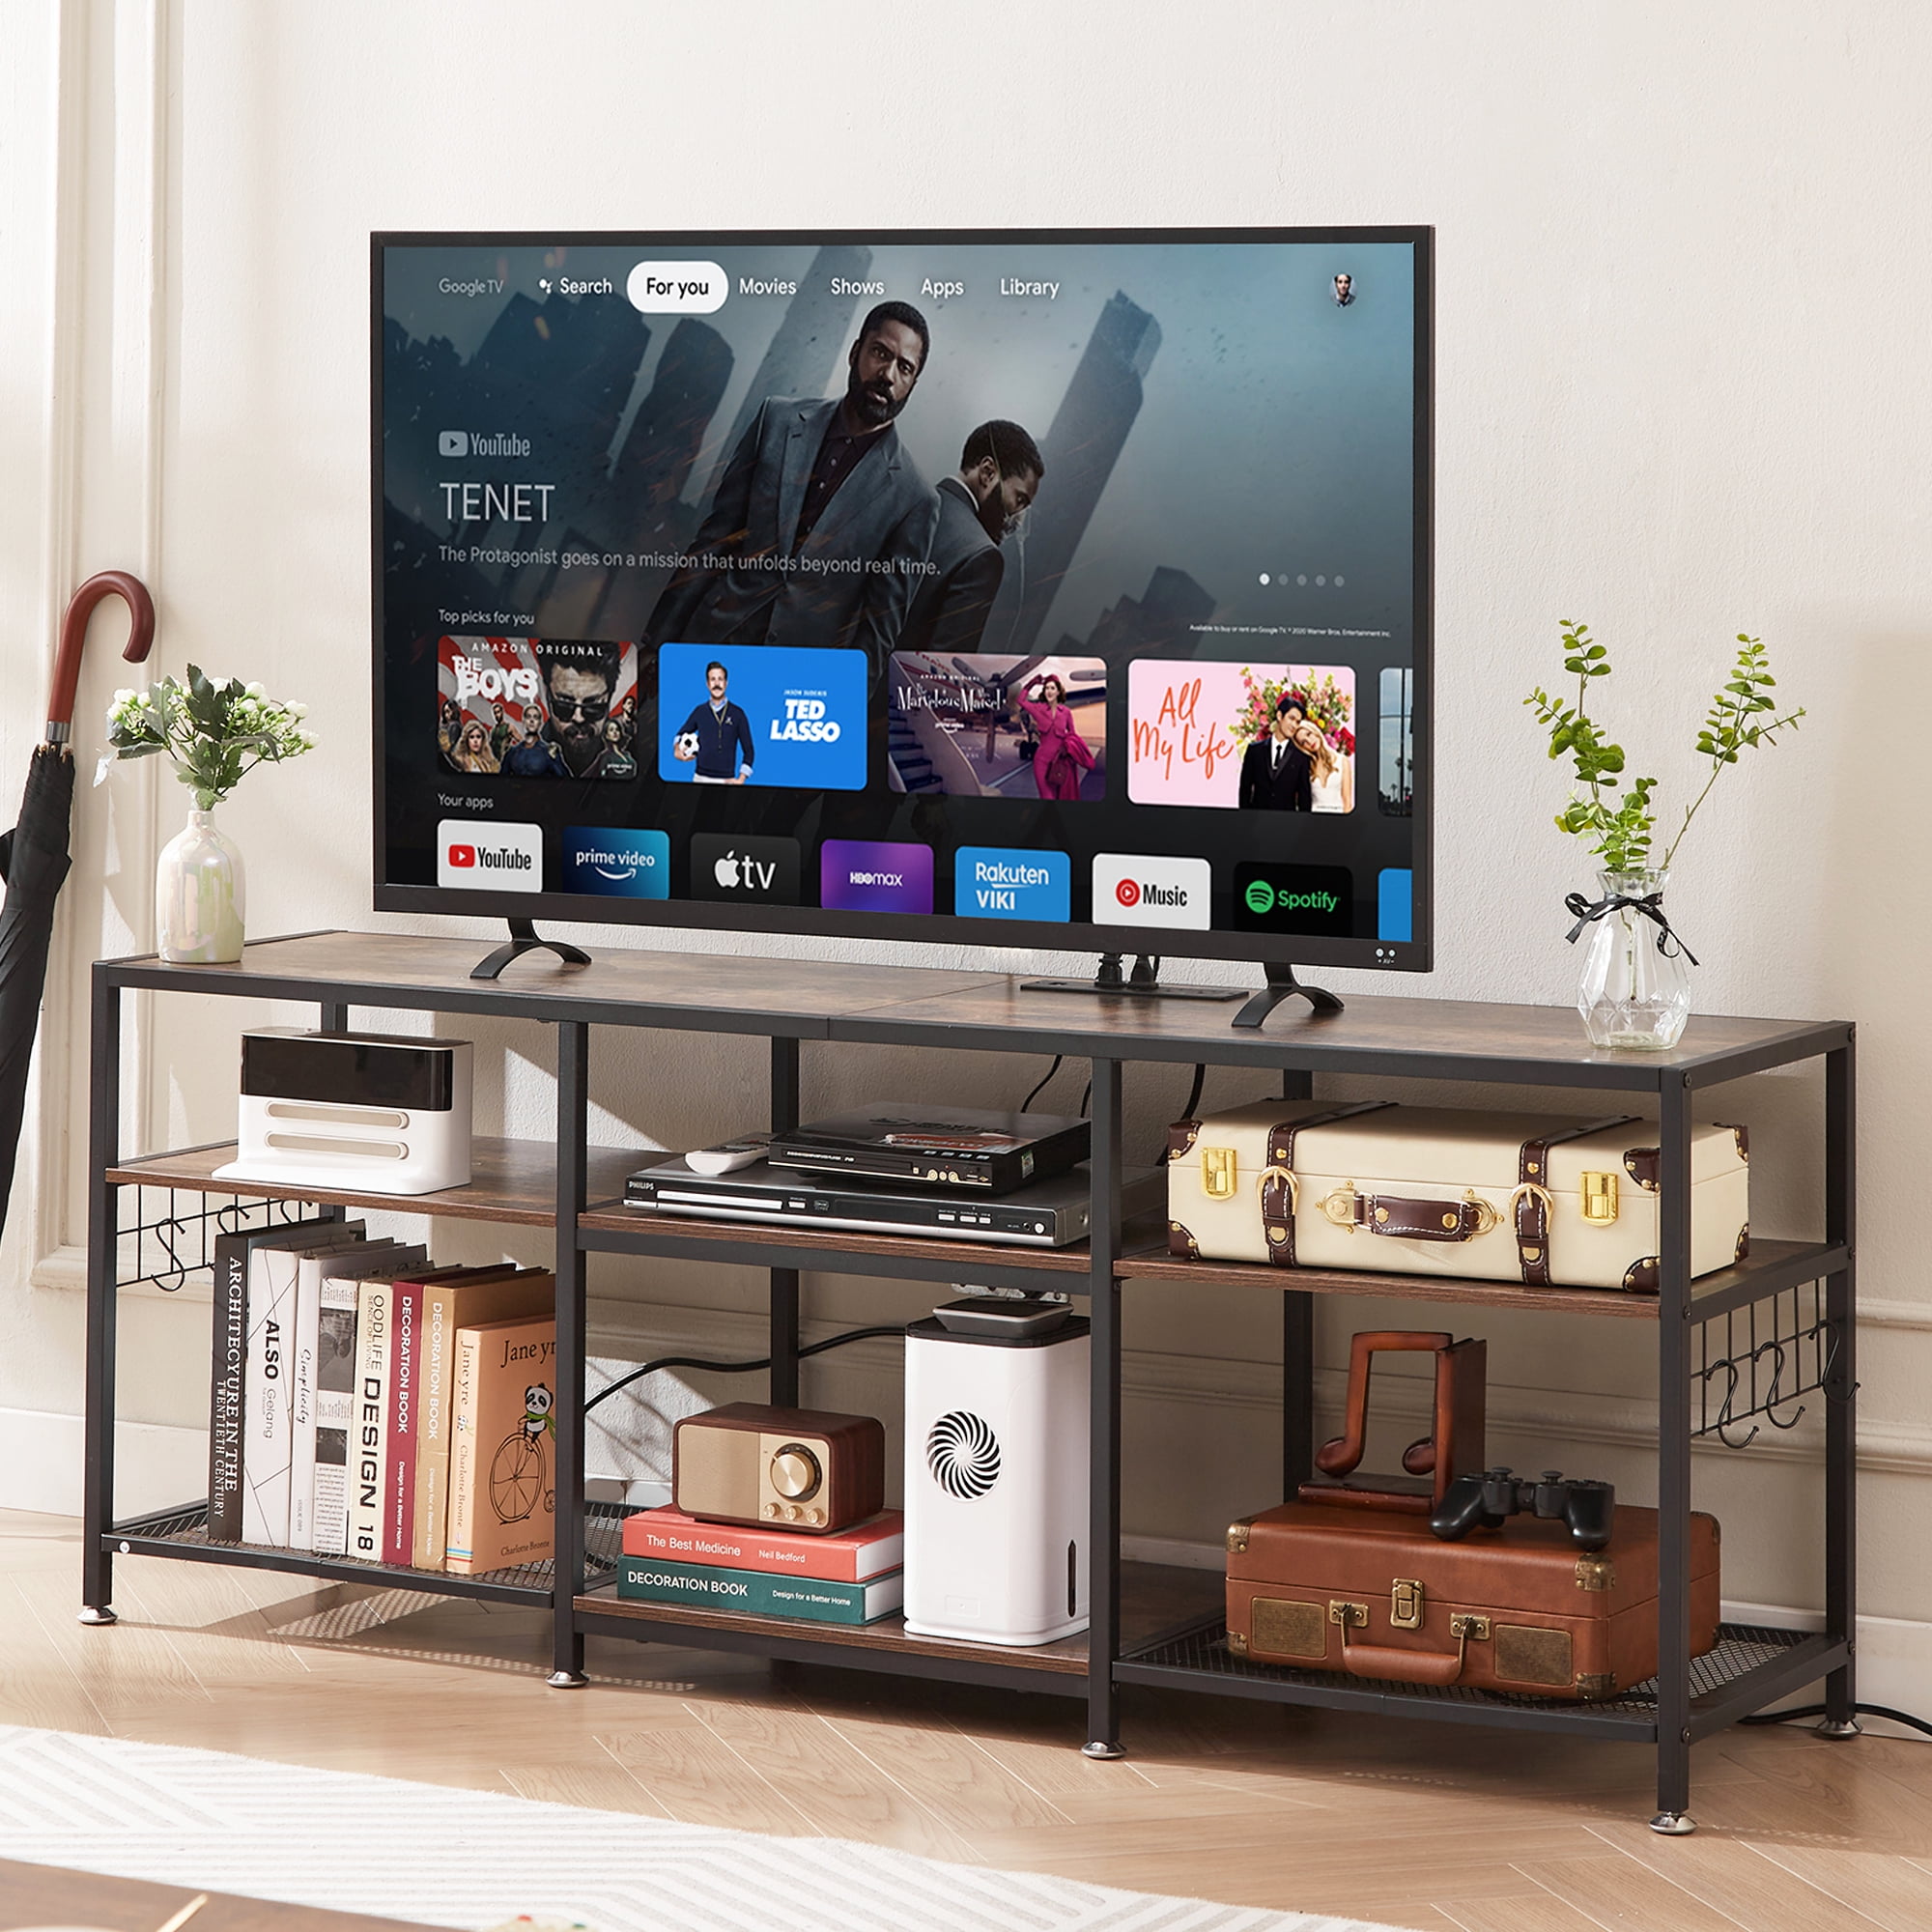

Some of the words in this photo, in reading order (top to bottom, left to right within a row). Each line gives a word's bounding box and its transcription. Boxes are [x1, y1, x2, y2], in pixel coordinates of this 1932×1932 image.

[439, 279, 485, 298] Google
[487, 280, 503, 294] TV
[560, 278, 612, 294] Search
[647, 278, 674, 294] For
[677, 281, 709, 299] you
[739, 278, 797, 295] Movies
[831, 278, 884, 295] Shows
[921, 278, 964, 299] Apps
[1001, 278, 1059, 300] Library
[470, 433, 530, 456] YouTube
[440, 483, 555, 522] TENET
[439, 545, 466, 562] The
[471, 546, 557, 568] Protagonist
[562, 553, 599, 569] goes
[603, 554, 622, 567] on
[626, 554, 636, 567] a
[639, 552, 697, 568] mission
[702, 554, 734, 569] that
[739, 554, 796, 571] unfolds
[801, 555, 861, 575] beyond
[866, 557, 895, 574] real
[899, 558, 940, 575] time.
[439, 610, 459, 625] Top
[461, 611, 491, 625] picks
[494, 611, 510, 624] for
[513, 614, 534, 626] you
[471, 642, 528, 654] AMAZON
[536, 644, 602, 656] ORIGINAL
[452, 655, 483, 672] THE
[456, 668, 539, 705] BOYS
[897, 686, 960, 710] Marvelous
[785, 698, 826, 720] TED
[960, 688, 1000, 713] Maisel
[1158, 678, 1201, 728] All
[770, 719, 841, 743] LASSO
[1134, 719, 1173, 781] My
[1182, 722, 1234, 780] Life
[438, 793, 463, 807] Your
[466, 797, 494, 810] apps
[478, 846, 532, 870] YouTube
[576, 849, 615, 867] prime
[618, 850, 655, 867] video
[742, 855, 776, 890] tv
[976, 863, 1049, 885] Rakuten
[976, 890, 1015, 910] VIKI
[1143, 884, 1188, 907] Music
[1278, 890, 1338, 913] Spotify
[629, 1180, 654, 1191] PHILIPS
[226, 1256, 242, 1417] ARCHITECYURE
[371, 1295, 384, 1371] OODLIFE
[398, 1296, 412, 1389] DECORATION
[264, 1320, 280, 1380] ALSO
[430, 1302, 442, 1395] DECORATION
[500, 1340, 537, 1368] Jane
[540, 1341, 556, 1365] yr
[215, 1380, 226, 1454] TWENTIETH
[263, 1388, 276, 1439] Gelang
[398, 1392, 409, 1434] BOOK
[428, 1398, 440, 1440] BOOK
[226, 1422, 239, 1445] IN
[360, 1378, 381, 1508] DESIGN
[225, 1449, 238, 1492] THE
[214, 1459, 225, 1518] CENTURY
[358, 1525, 374, 1551] 18
[646, 1534, 666, 1548] The
[669, 1537, 693, 1551] Best
[696, 1540, 741, 1557] Medicine
[759, 1549, 775, 1560] Neil
[776, 1550, 806, 1563] Bedford
[628, 1571, 708, 1593] DECORATION
[711, 1582, 748, 1596] BOOK
[772, 1589, 794, 1601] Design
[795, 1591, 805, 1600] for
[811, 1593, 831, 1604] Better
[832, 1596, 851, 1606] Home
